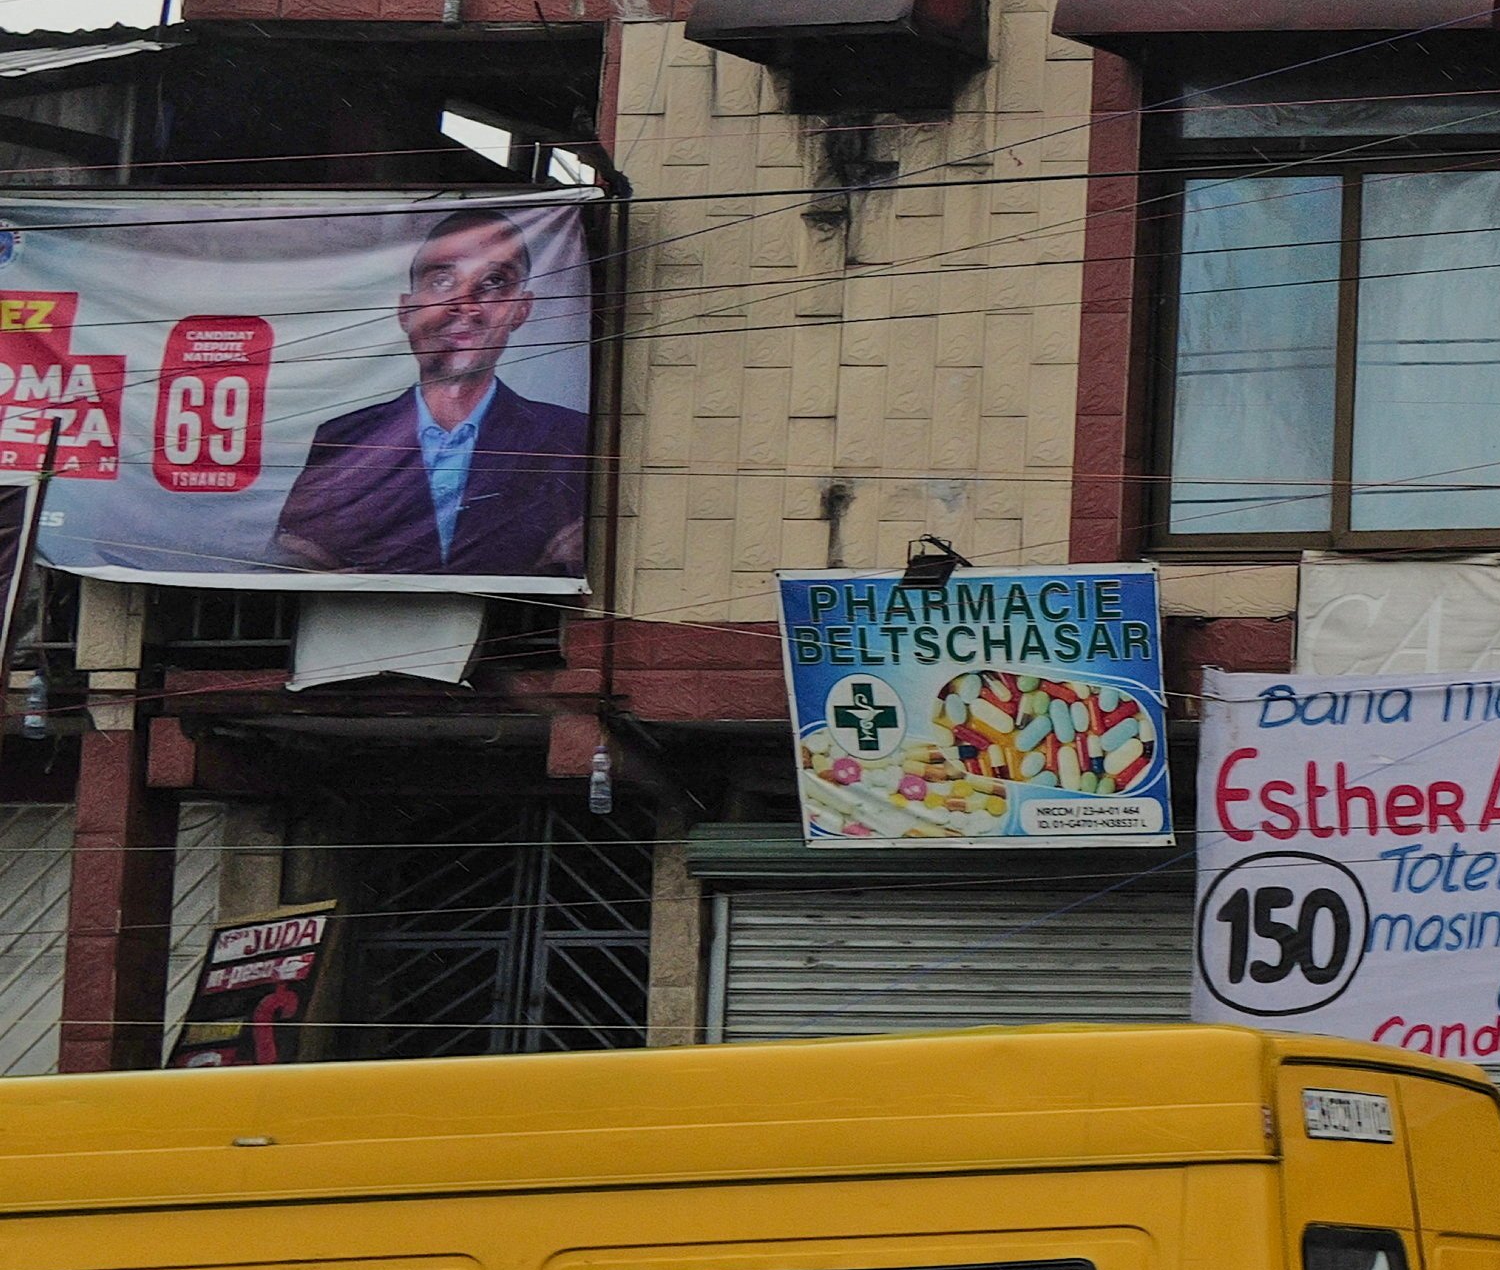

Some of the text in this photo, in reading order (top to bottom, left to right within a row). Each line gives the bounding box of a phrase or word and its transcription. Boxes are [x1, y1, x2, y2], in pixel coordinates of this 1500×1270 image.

[186, 331, 255, 340] CANDIDAT
[193, 342, 244, 351] DEPUTE
[183, 353, 249, 361] NATIONAL
[164, 376, 249, 464] 69
[809, 580, 1122, 623] PHARMACIE
[797, 622, 1150, 664] BELTSCHASAR
[244, 918, 319, 954] JUDA
[1217, 887, 1351, 985] 150
